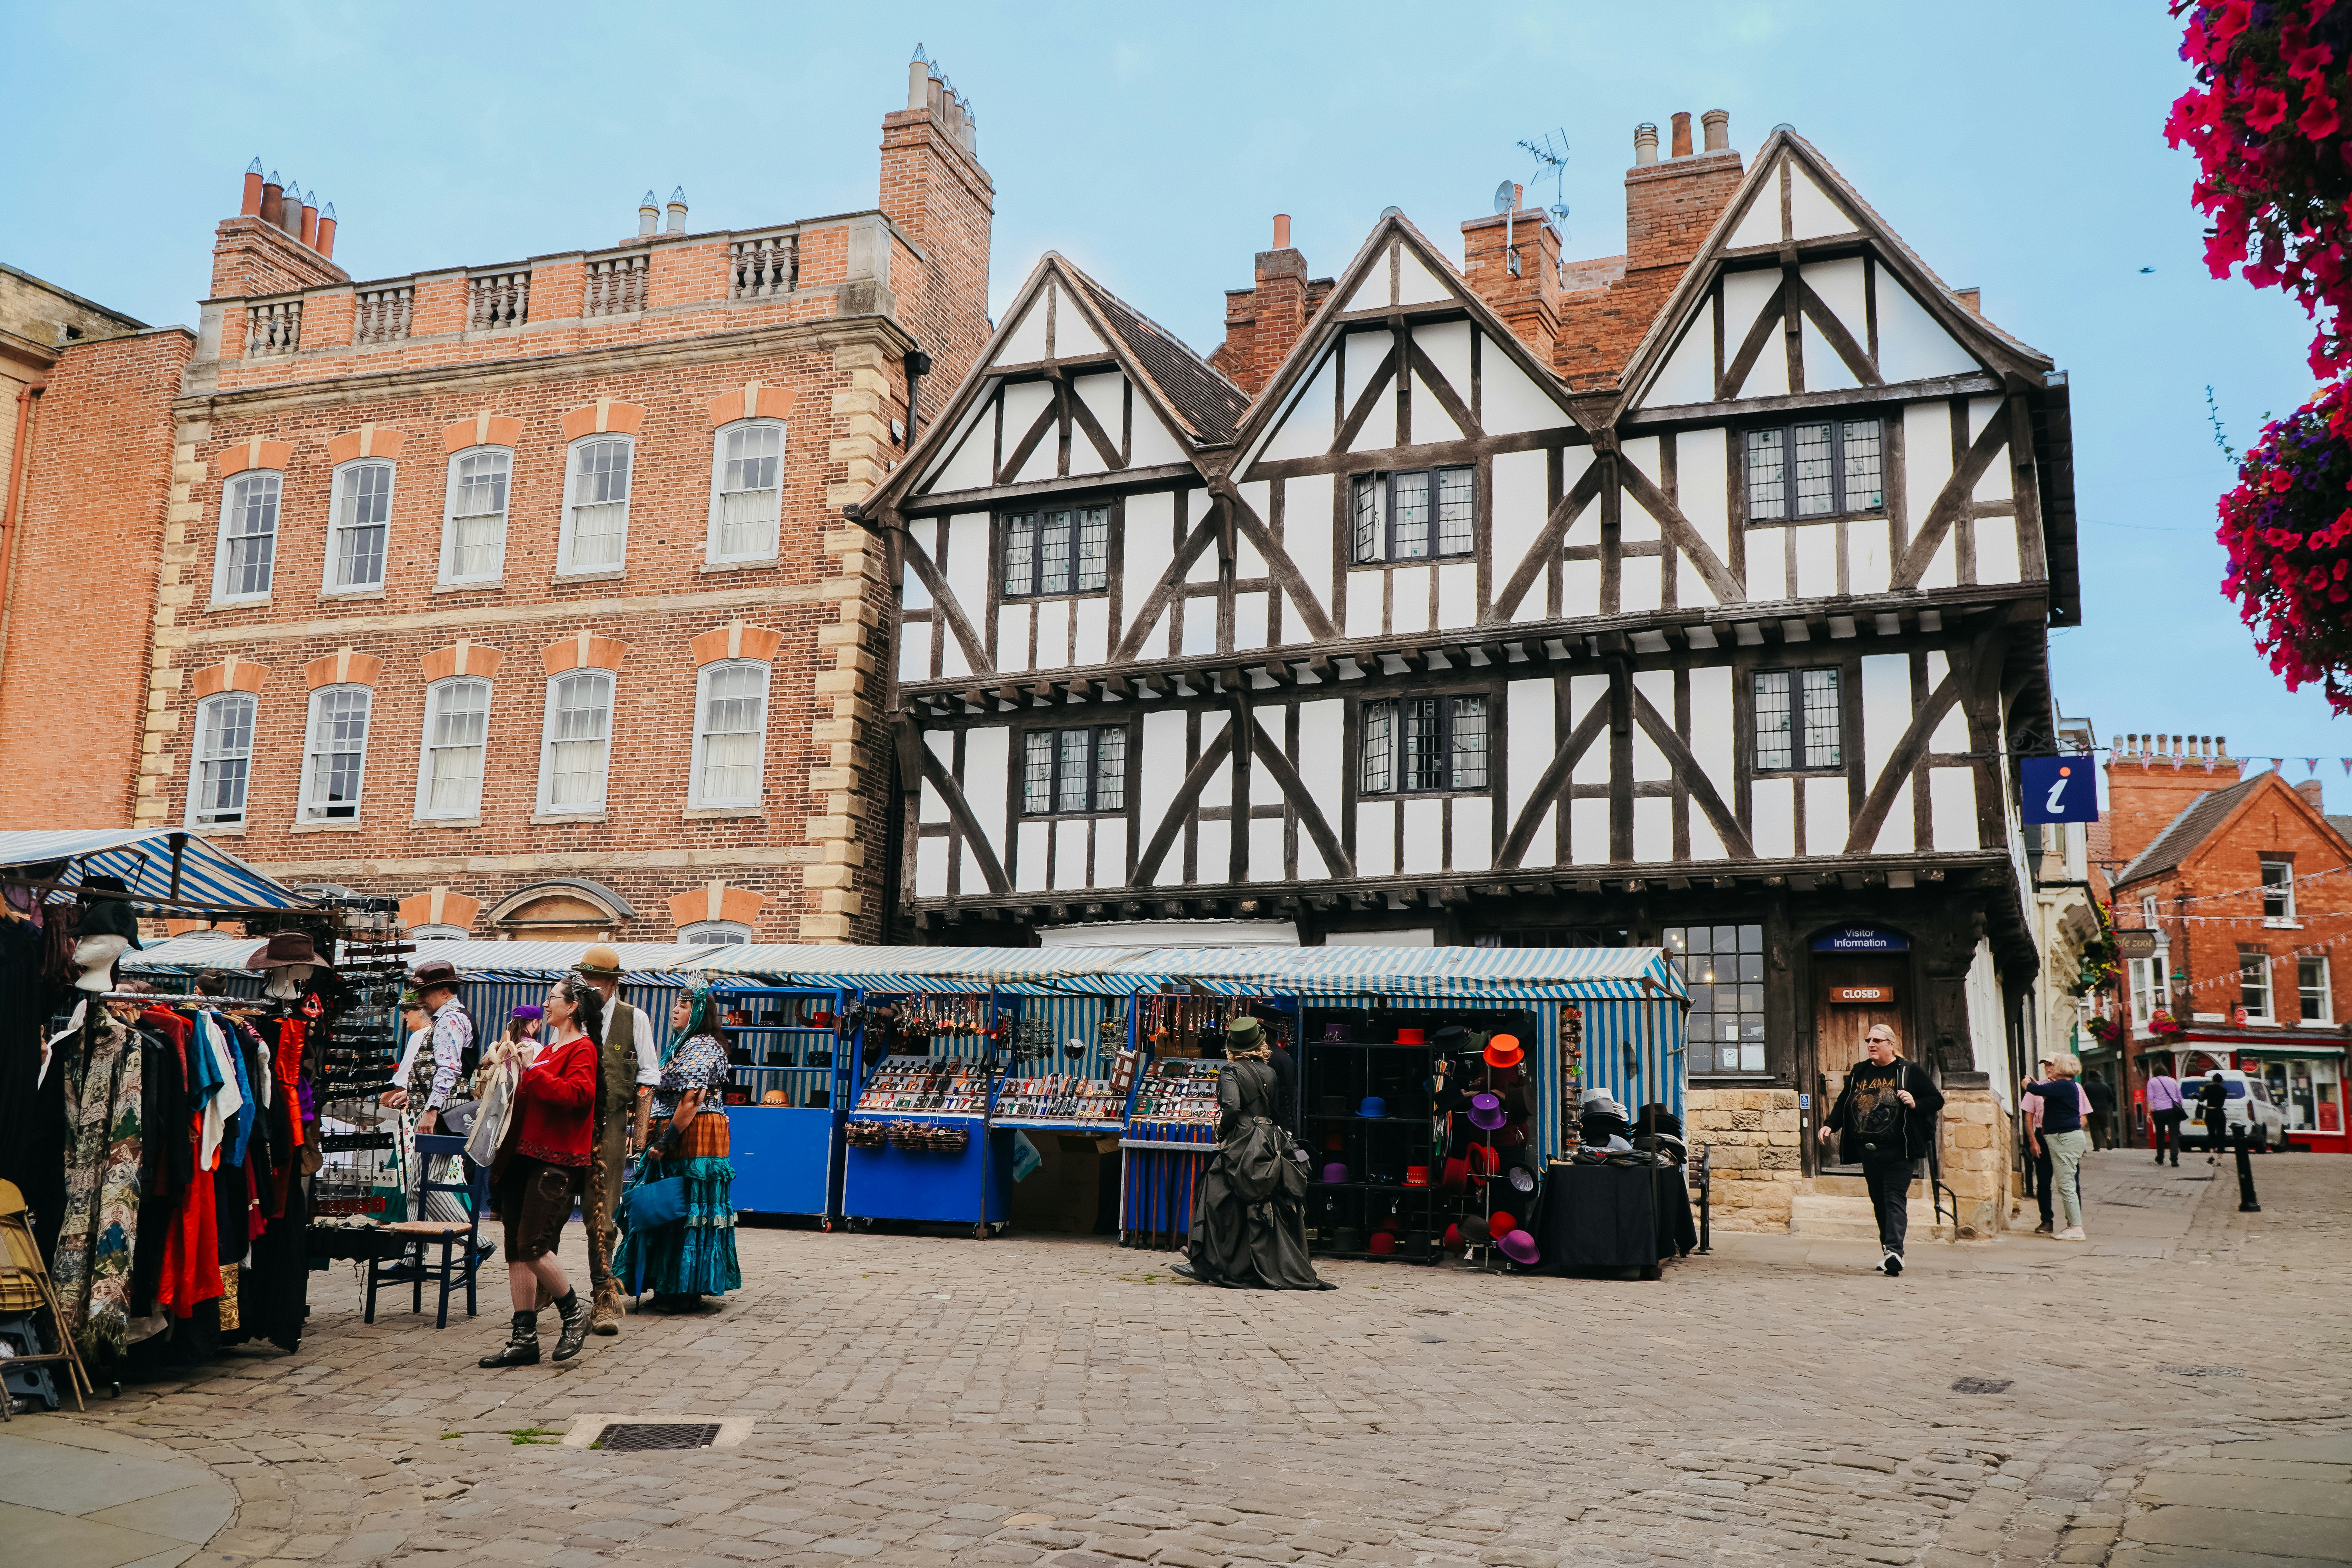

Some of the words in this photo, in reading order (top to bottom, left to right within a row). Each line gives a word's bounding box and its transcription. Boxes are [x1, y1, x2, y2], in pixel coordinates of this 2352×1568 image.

[2046, 766, 2071, 814] i
[1845, 929, 1874, 937] Visitor
[1834, 938, 1886, 947] Information
[1842, 989, 1880, 998] CLOSED
